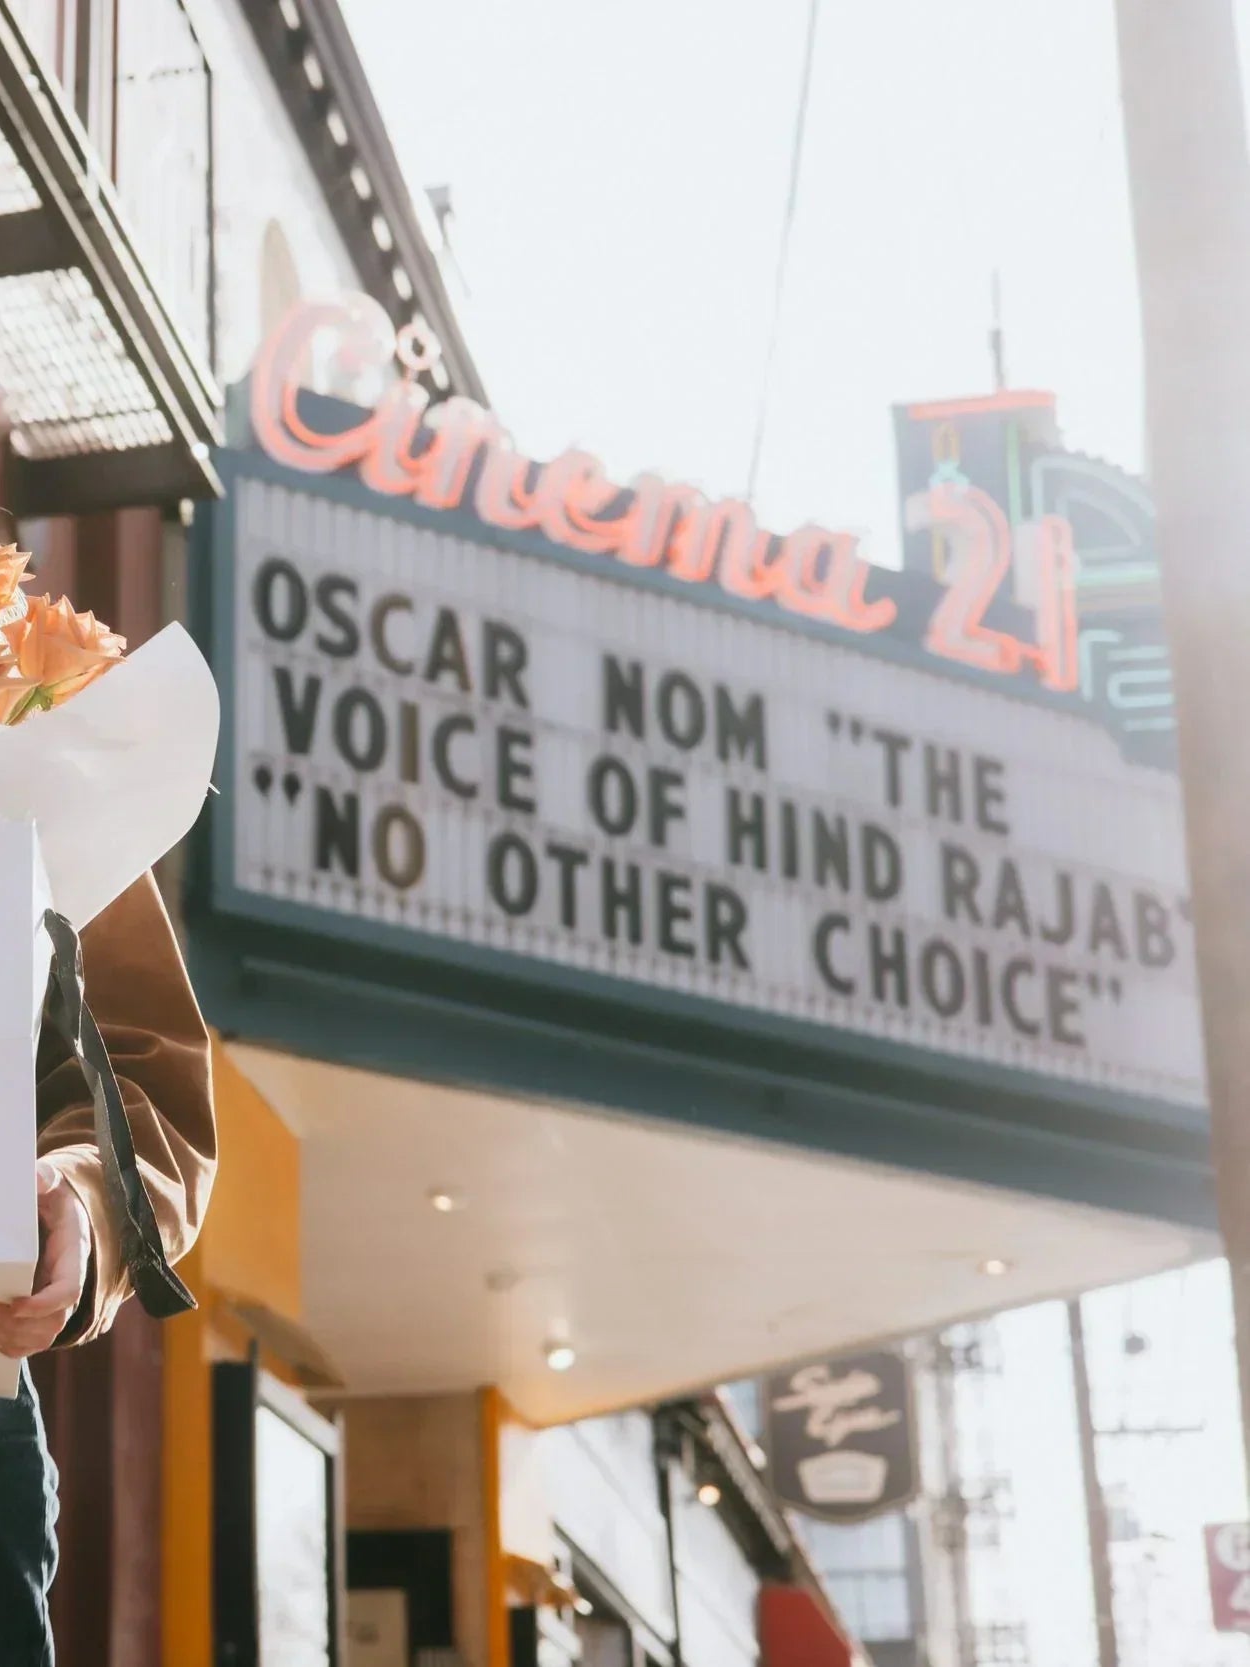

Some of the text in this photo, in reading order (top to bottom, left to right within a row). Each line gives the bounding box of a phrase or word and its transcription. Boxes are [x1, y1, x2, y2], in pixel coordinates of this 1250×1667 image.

[252, 291, 1078, 692] Cinema 21
[253, 556, 528, 709] OSCAR
[603, 654, 768, 773] NOM
[273, 665, 536, 815] VOICE
[587, 754, 687, 848] OF
[725, 787, 905, 902] HIND
[486, 832, 751, 970] OTHER
